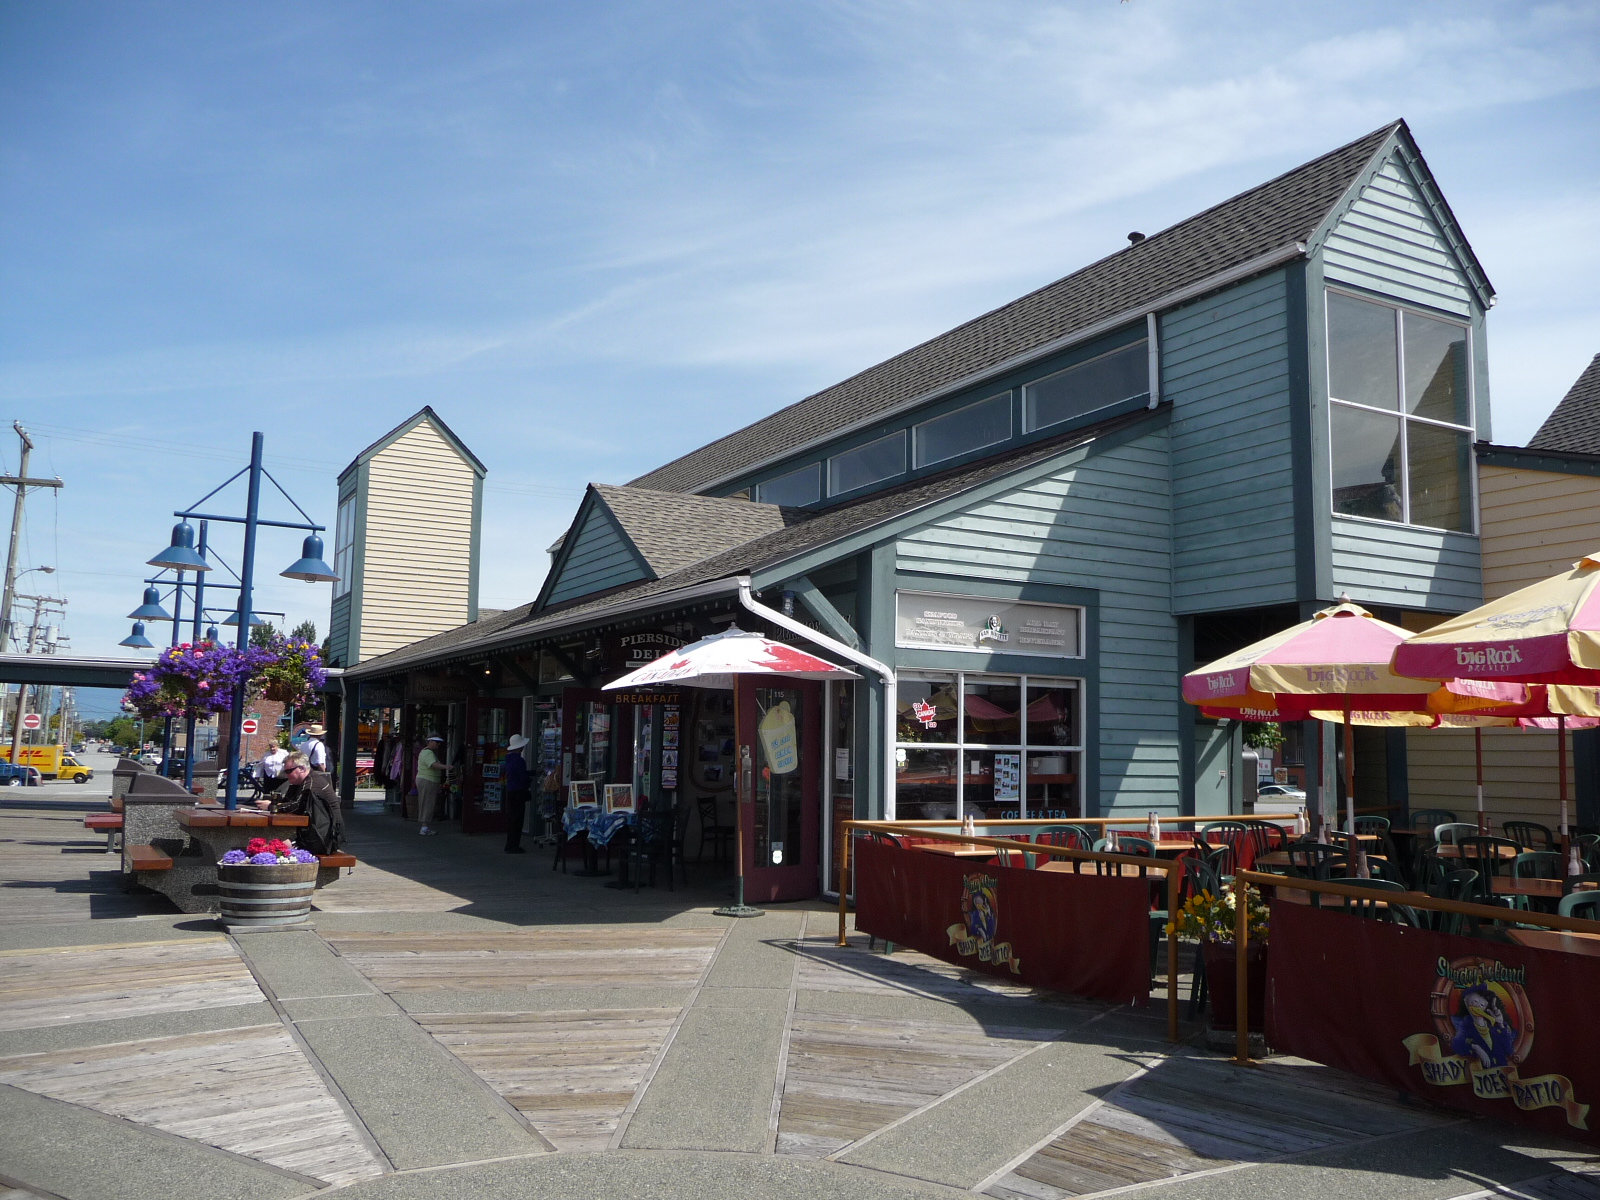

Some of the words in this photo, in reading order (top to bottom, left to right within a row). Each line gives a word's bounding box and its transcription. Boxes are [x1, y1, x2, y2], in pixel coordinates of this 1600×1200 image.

[632, 649, 670, 659] DEL
[615, 693, 680, 704] BREAKFAST
[484, 765, 498, 774] OPEN
[1000, 810, 1037, 819] COFEE
[1038, 810, 1045, 819] &
[1047, 810, 1068, 819] TEA
[1437, 956, 1479, 989] Shady
[1424, 1060, 1469, 1081] SHADY
[1474, 1069, 1509, 1095] JOE'S
[1513, 1080, 1561, 1106] PATIO
